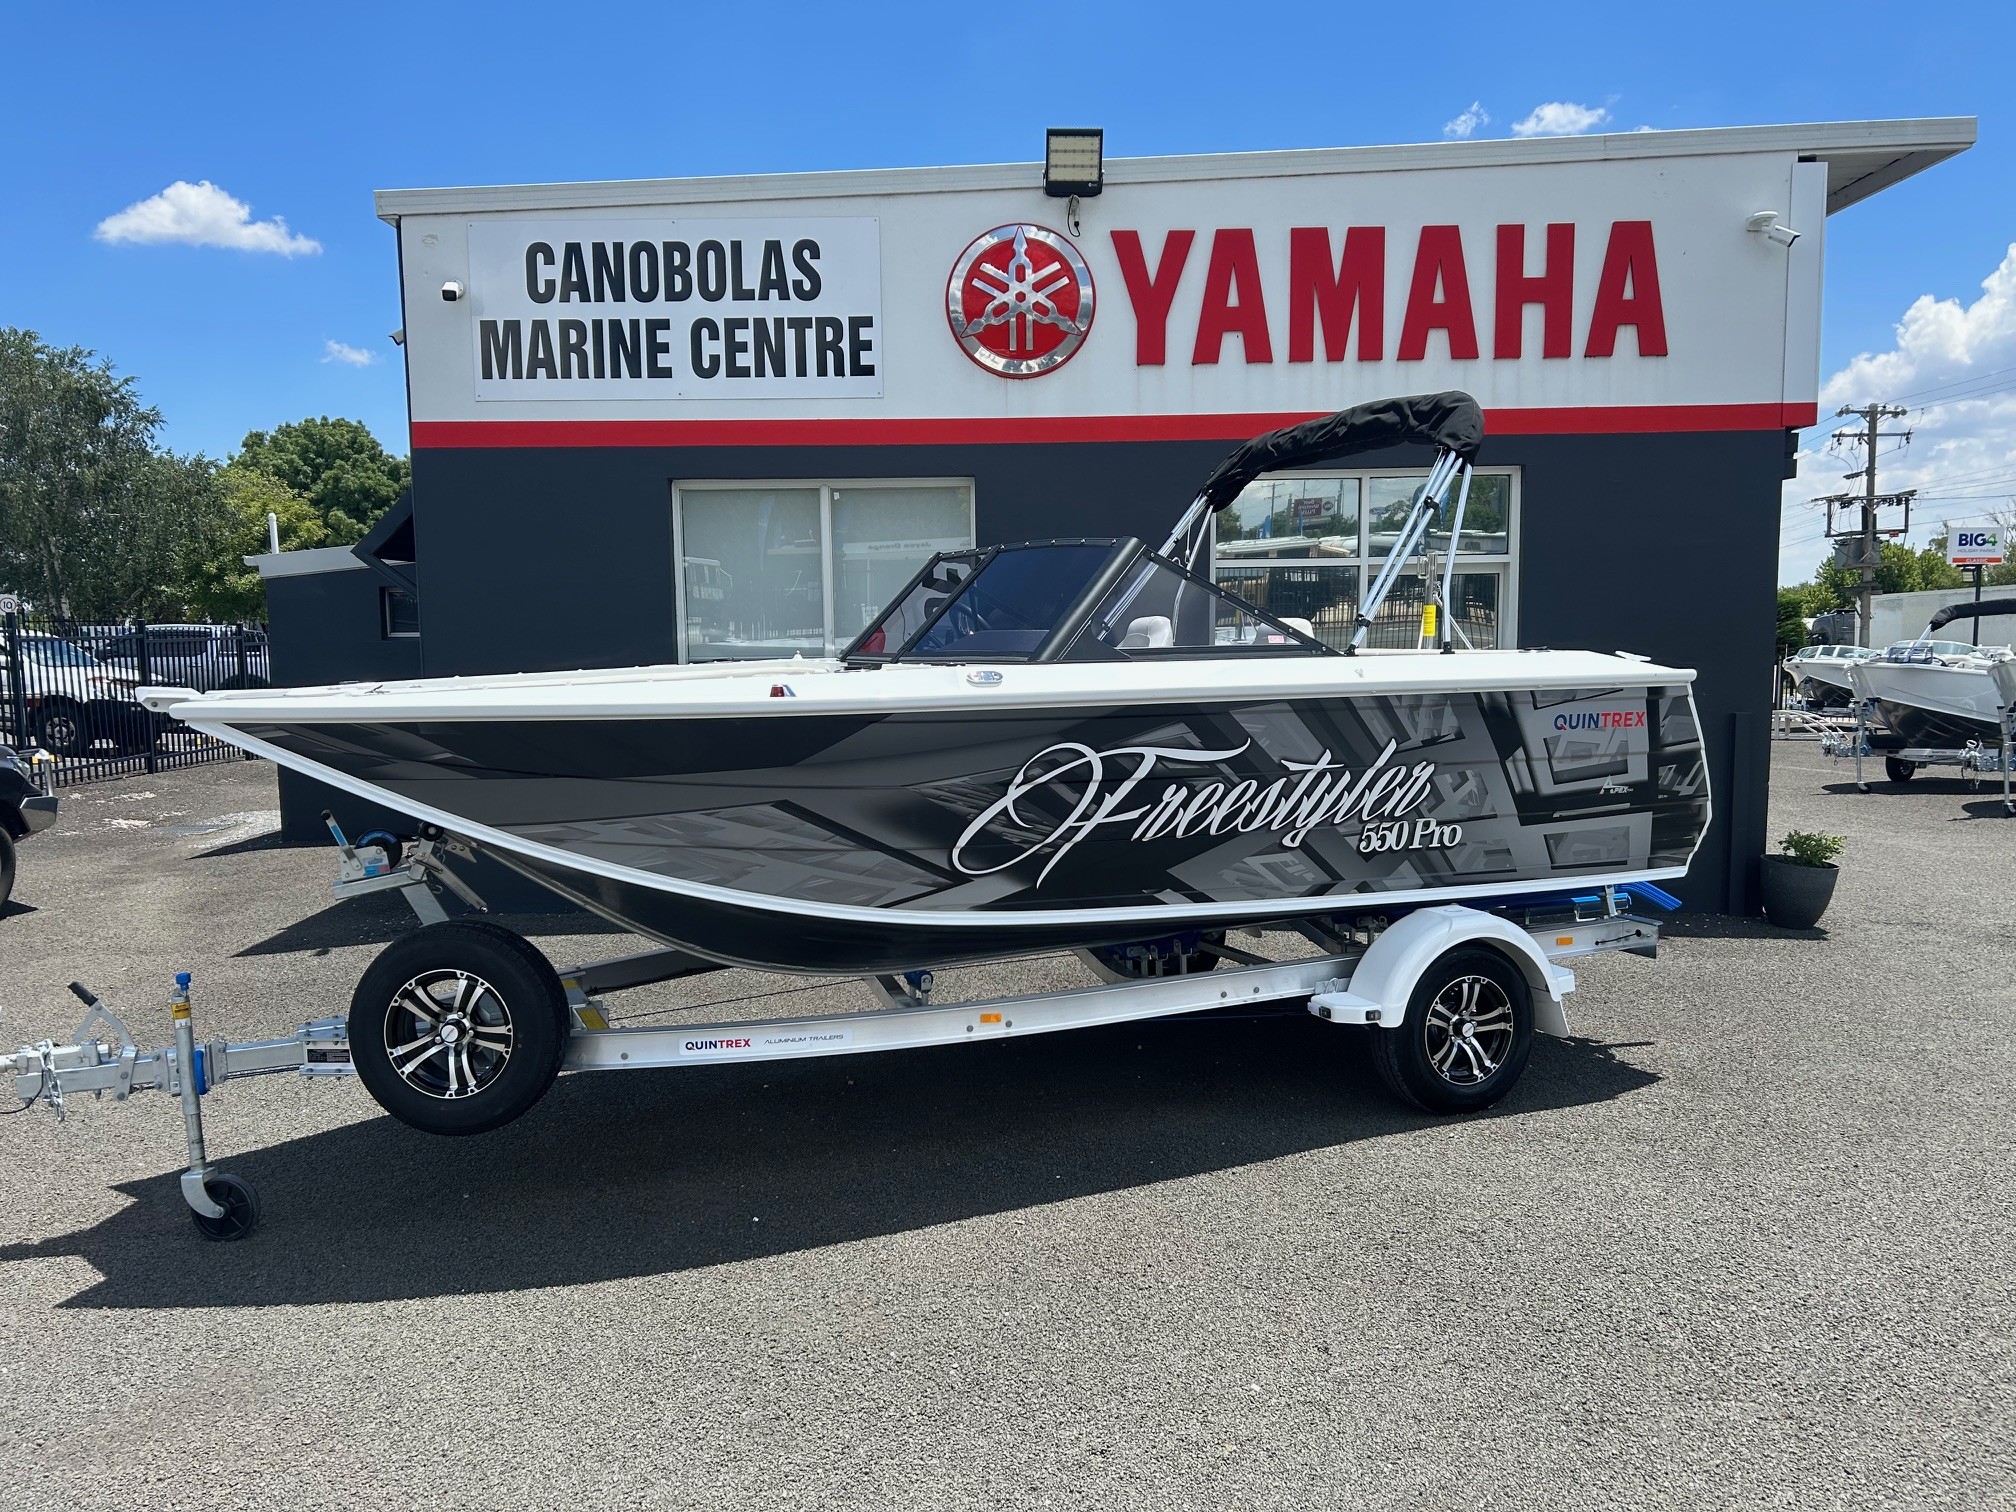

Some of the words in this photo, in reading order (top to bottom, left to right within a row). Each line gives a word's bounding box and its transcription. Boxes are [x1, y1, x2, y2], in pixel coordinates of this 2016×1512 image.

[525, 238, 822, 304] CANOBOLAS
[1110, 220, 1668, 366] YAMAHA
[479, 318, 673, 380] MARINE
[690, 316, 876, 380] CENTRE
[1958, 532, 1998, 547] BIG4
[3, 601, 13, 610] 10
[1554, 711, 1646, 731] QUINTREX
[952, 737, 1435, 889] Freestyler
[1358, 822, 1409, 854] 550
[1409, 817, 1463, 850] Pro
[685, 1038, 751, 1051] QUINTREX
[764, 1036, 807, 1045] ALUMINIUM
[808, 1033, 844, 1042] TRAILERS
